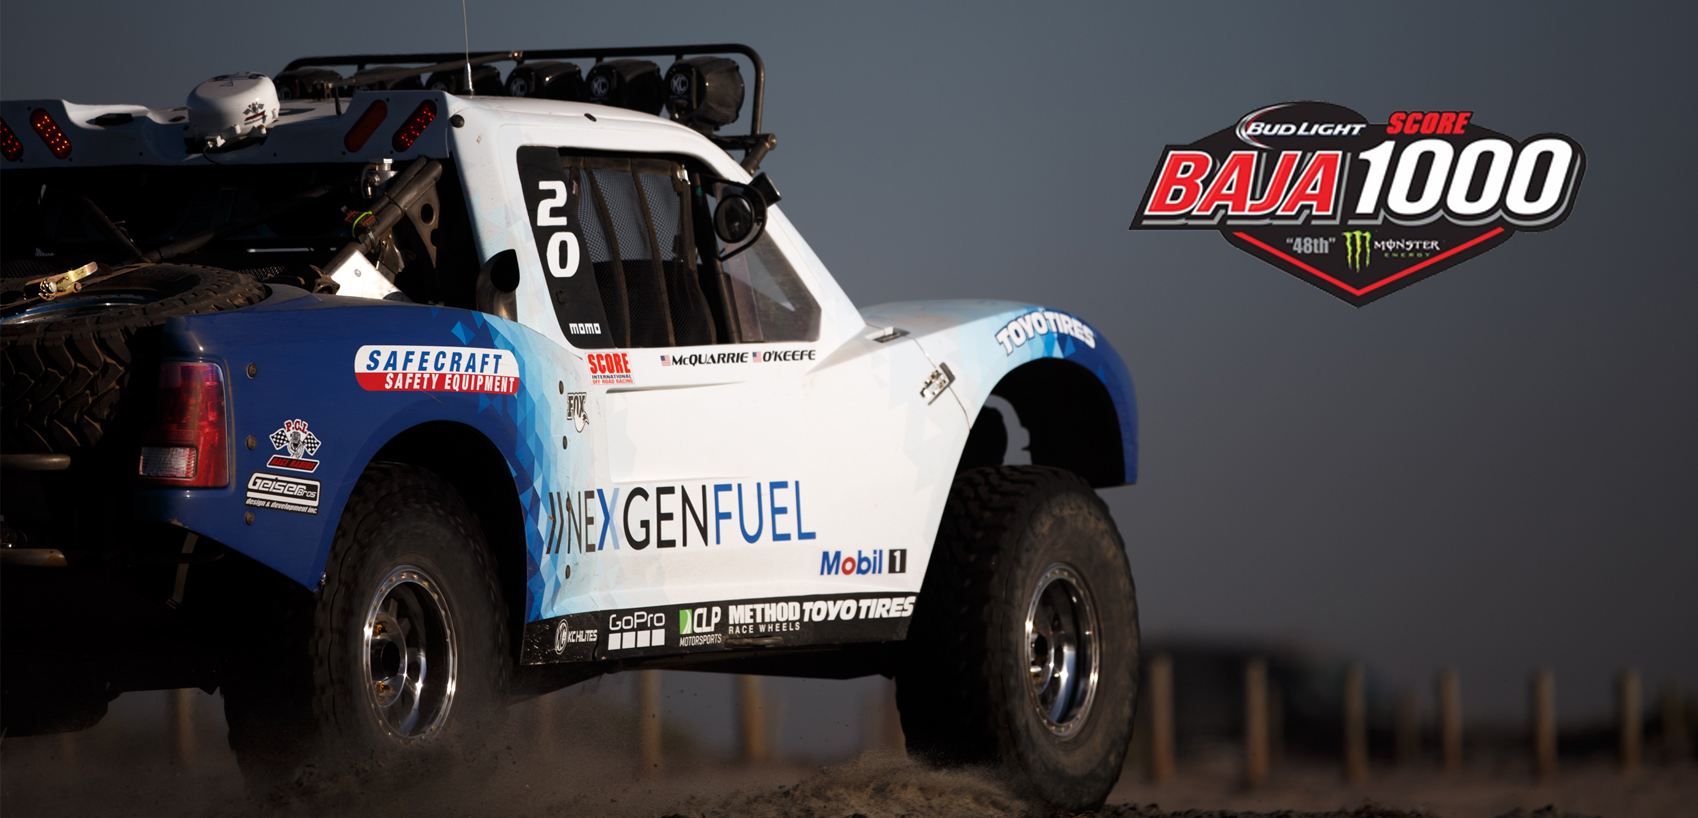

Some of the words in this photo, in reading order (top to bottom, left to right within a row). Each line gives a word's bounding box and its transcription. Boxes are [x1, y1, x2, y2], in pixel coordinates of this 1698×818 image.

[671, 75, 688, 94] KC
[995, 310, 1049, 357] TOYO
[1042, 310, 1096, 349] TIRES
[366, 350, 502, 374] SAFECRAFT
[587, 353, 631, 374] SCORE
[672, 352, 748, 366] McQUARRIE
[763, 350, 816, 362] O'KEEFE
[385, 373, 439, 390] SAFETY
[444, 374, 514, 393] EQUIPMENT
[567, 392, 587, 420] FOX
[246, 498, 266, 507] design
[270, 501, 308, 512] development
[820, 550, 883, 576] Mobil
[693, 606, 722, 633] CLP
[728, 601, 801, 625] METHOD
[803, 599, 858, 622] TOYO
[859, 596, 917, 619] TIRES
[609, 612, 665, 631] GoPro
[728, 624, 754, 635] RACE
[759, 622, 801, 633] WHEELS
[679, 634, 722, 647] MOTORSPORTS
